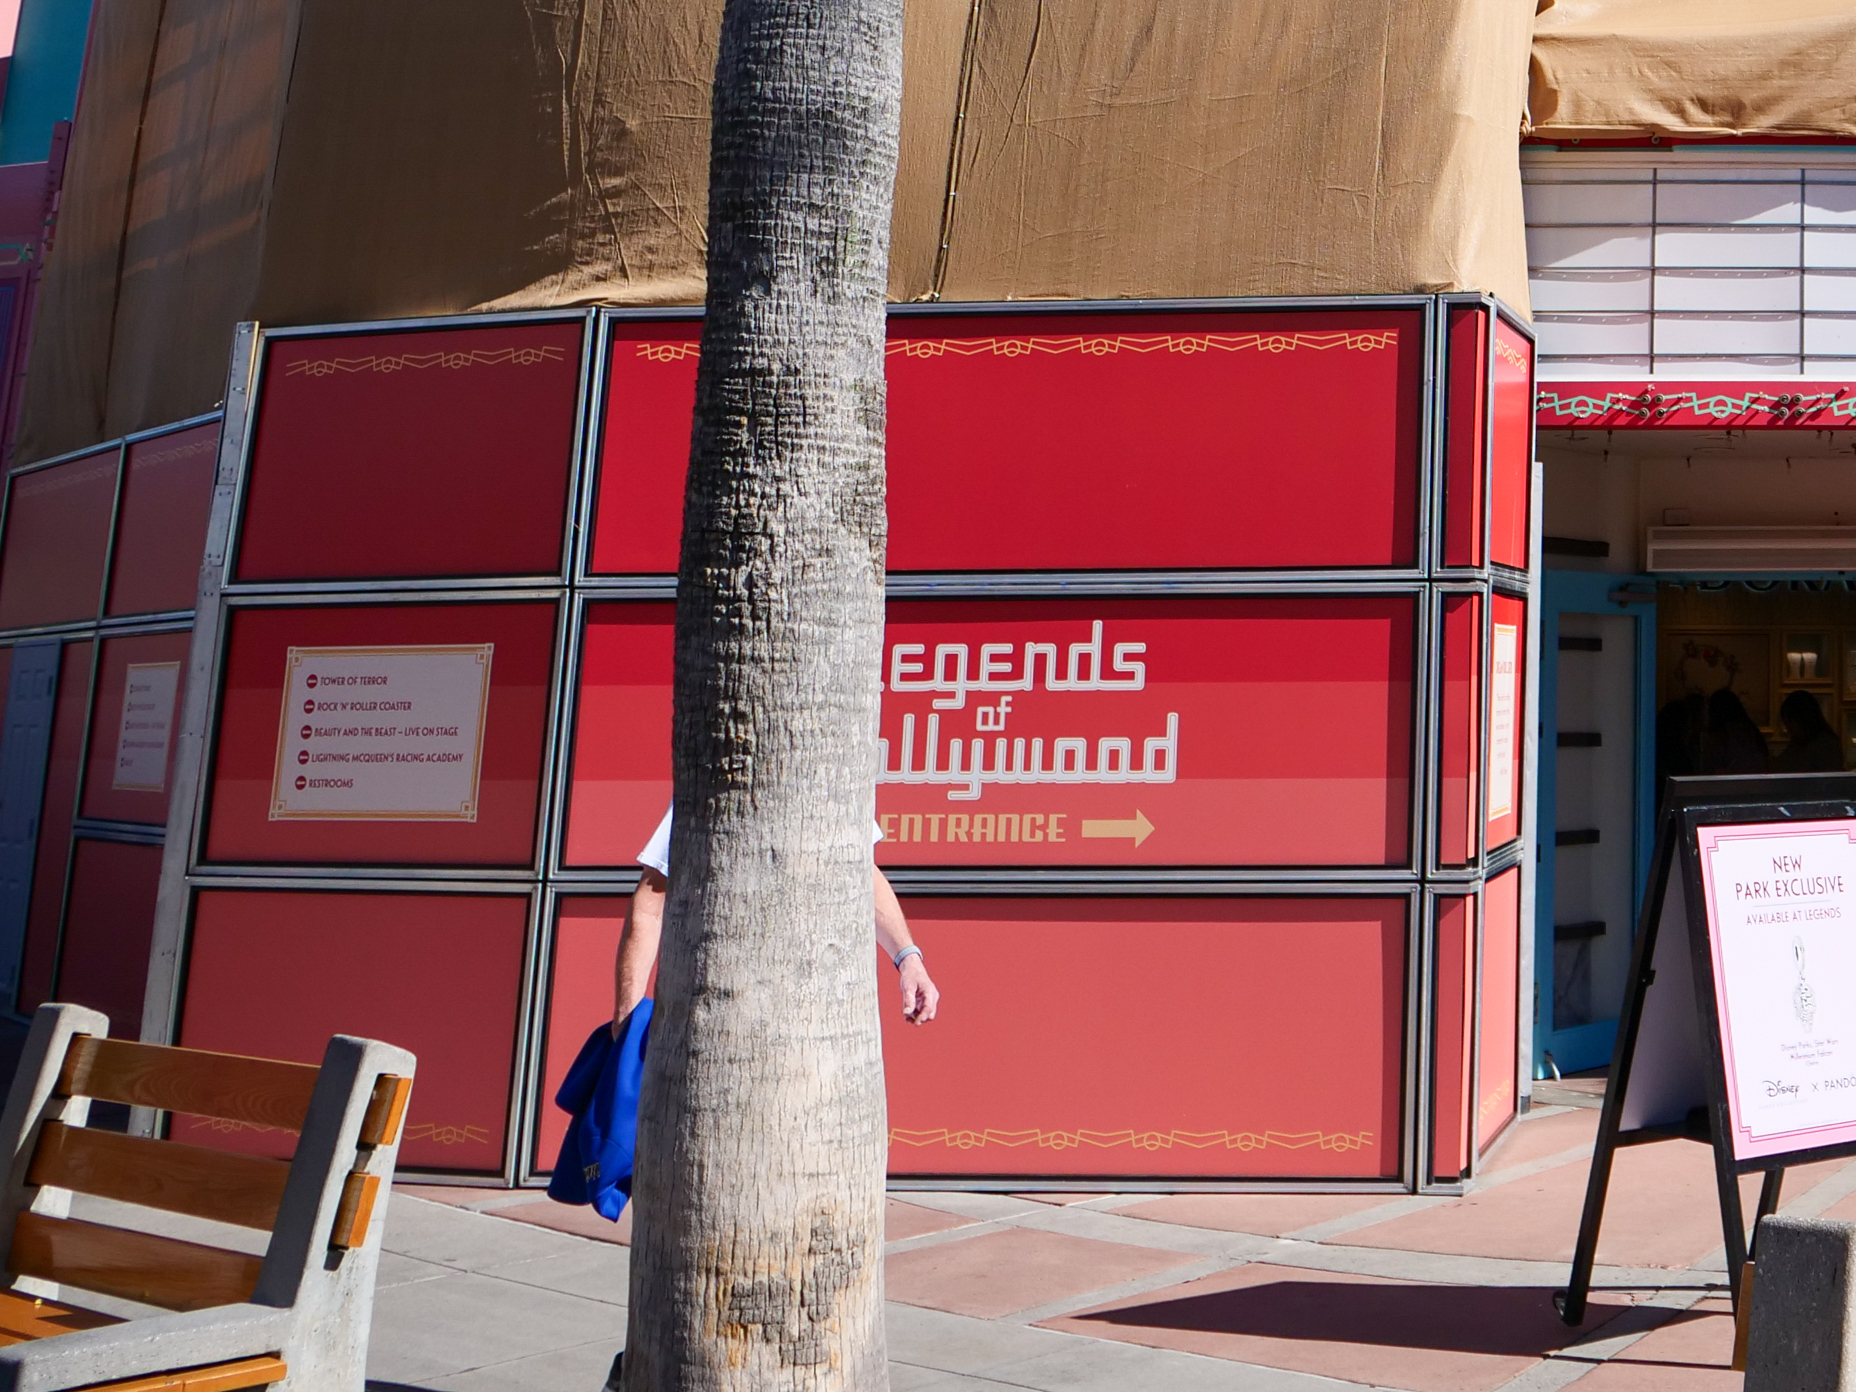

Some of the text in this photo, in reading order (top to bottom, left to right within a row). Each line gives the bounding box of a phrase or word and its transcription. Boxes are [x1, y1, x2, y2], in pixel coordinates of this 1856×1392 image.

[876, 620, 1146, 709] egends
[320, 676, 388, 686] TOWER OF TERROR
[317, 702, 339, 711] ROCK
[351, 702, 377, 711] ROLLER
[379, 702, 412, 711] COASTER
[976, 695, 1013, 731] of
[314, 727, 341, 737] BEAUTY
[343, 727, 359, 737] AND
[361, 727, 373, 737] THE
[375, 727, 397, 737] BEAST
[404, 727, 420, 737] LIVE
[421, 727, 435, 736] ON
[436, 727, 459, 736] STAGE
[311, 753, 350, 763] LIGHTNING
[396, 753, 425, 763] RACING
[426, 753, 464, 763] ACADEMY
[308, 779, 353, 788] RESTROOMS
[880, 813, 1067, 842] ENTRANCE
[1772, 854, 1802, 874] NEW
[1735, 875, 1844, 901] PARK EXCLUSIVE
[1746, 907, 1842, 925] AVAILABLE AT LEGENDS
[1762, 1079, 1800, 1098] Disney
